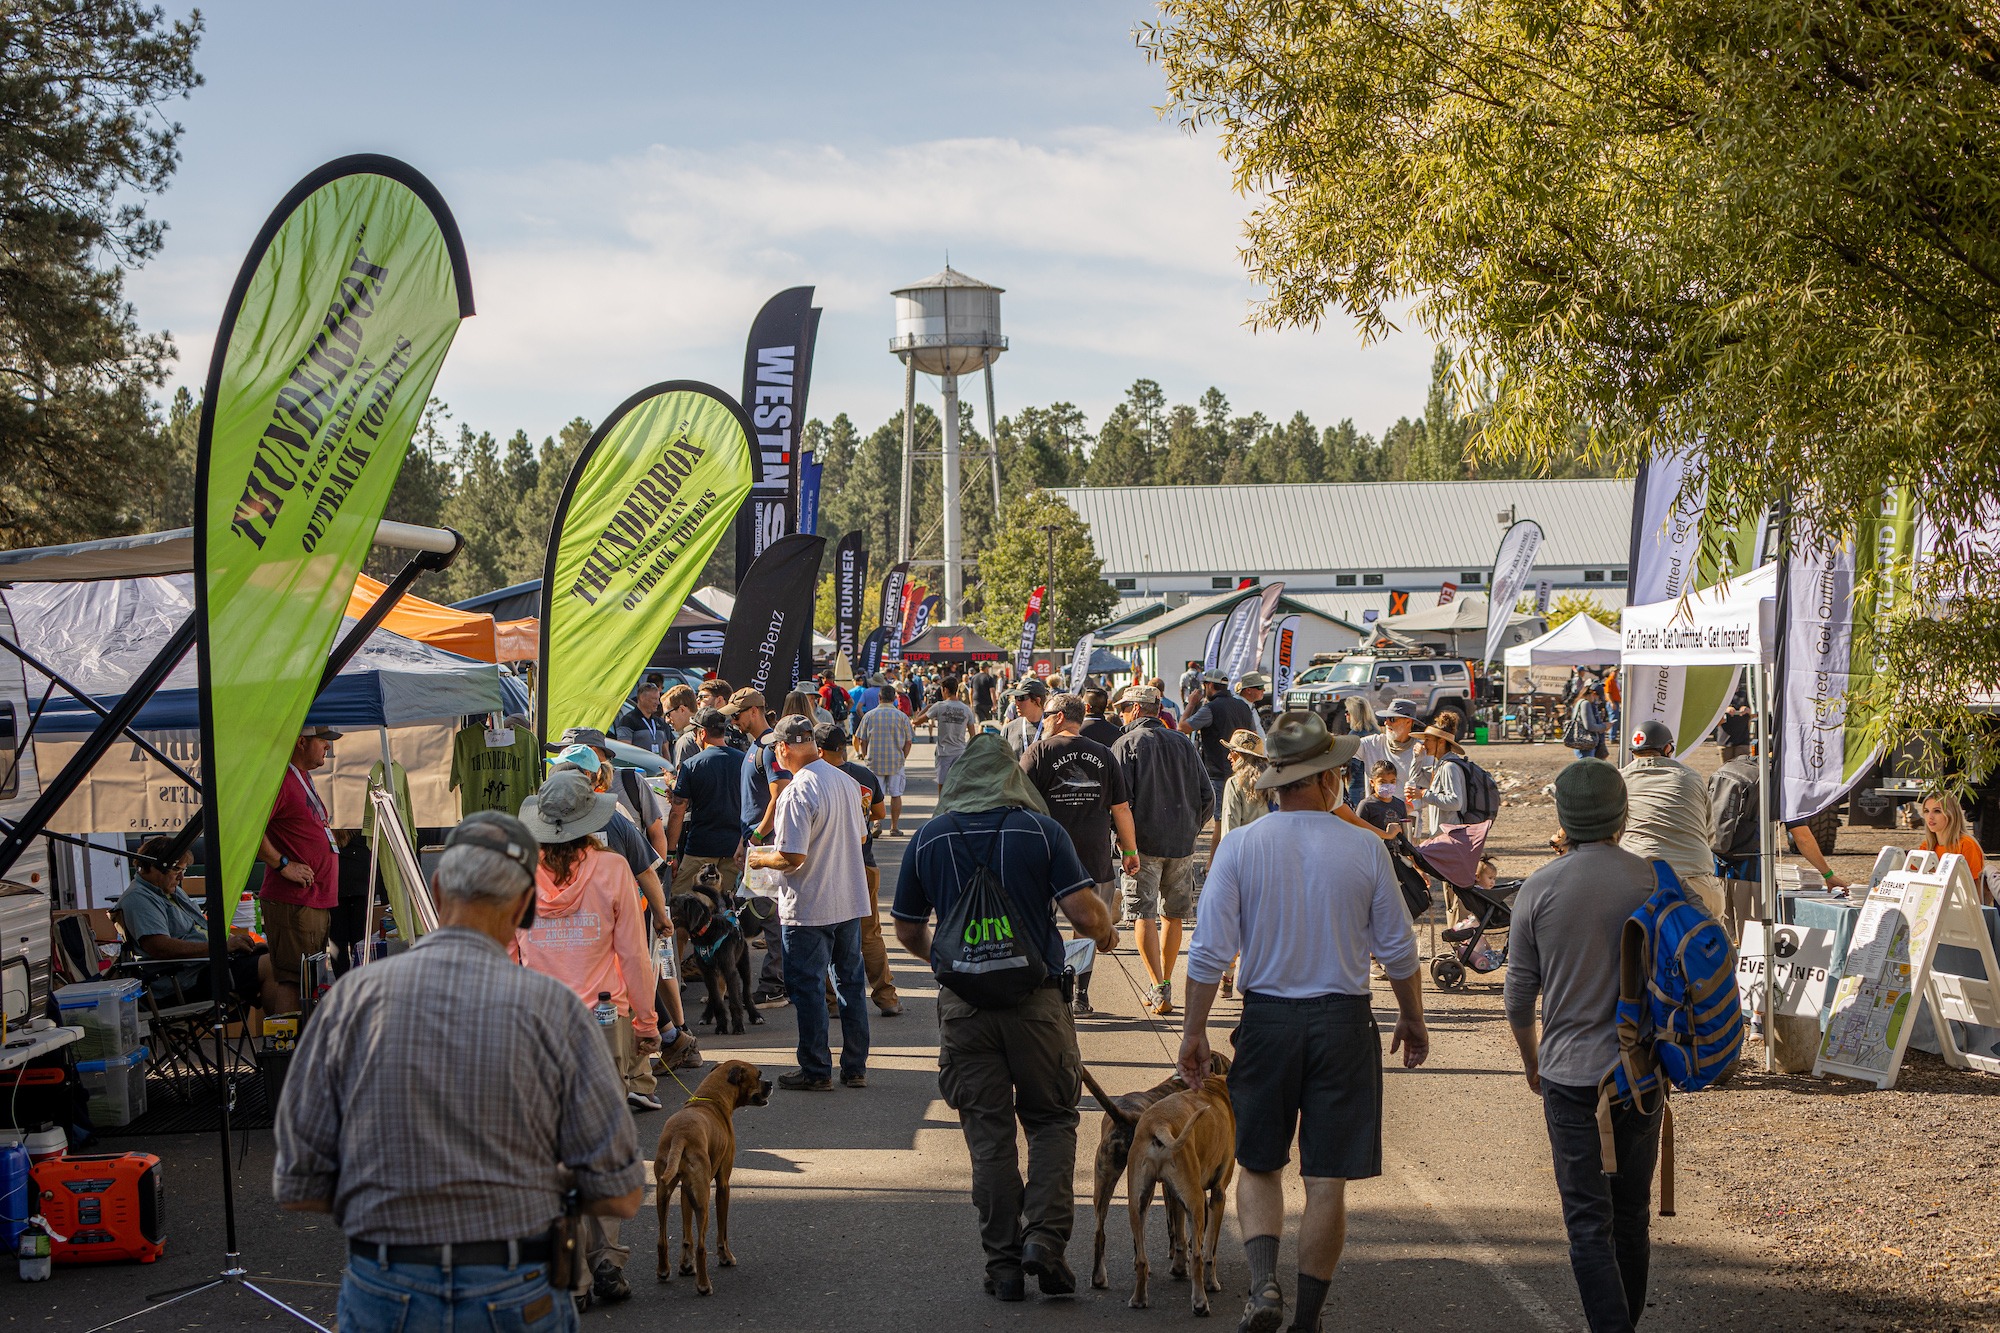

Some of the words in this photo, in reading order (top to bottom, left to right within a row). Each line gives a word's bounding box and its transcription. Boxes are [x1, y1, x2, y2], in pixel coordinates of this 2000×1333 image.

[231, 247, 389, 551] THUNDERBOX
[302, 355, 377, 500] AUSTRALIAN
[302, 437, 370, 554] OUTBACK
[356, 334, 413, 439] TOILETS
[570, 434, 705, 607] THUNDERBOX
[1672, 516, 1687, 545] Get
[622, 545, 680, 612] OUTBACK
[671, 488, 717, 549] TOILETS
[627, 497, 689, 579] AUSTRALIAN
[841, 549, 854, 618] RUNNER
[1665, 558, 1682, 599] tfitted
[886, 573, 899, 625] KINETIK
[938, 636, 964, 651] 22
[1627, 629, 1636, 649] Get
[1637, 628, 1658, 649] Trained
[1663, 628, 1674, 649] Get
[1674, 626, 1703, 649] Outfitted
[1708, 626, 1719, 648] Get
[1721, 623, 1750, 653] Inspired
[1817, 624, 1831, 656] Get
[1037, 663, 1050, 673] 22
[471, 751, 522, 771] THUNDERBOX
[1052, 751, 1078, 770] SALTY
[1081, 752, 1104, 769] CREW
[1810, 739, 1825, 770] Get
[1880, 887, 1891, 896] EXPO
[1881, 880, 1905, 890] OVERLAND
[546, 928, 583, 939] ANGLERS
[573, 916, 595, 927] FORK
[989, 950, 1013, 959] Tactical
[1739, 956, 1785, 977] EVET
[1789, 962, 1826, 982] INFO
